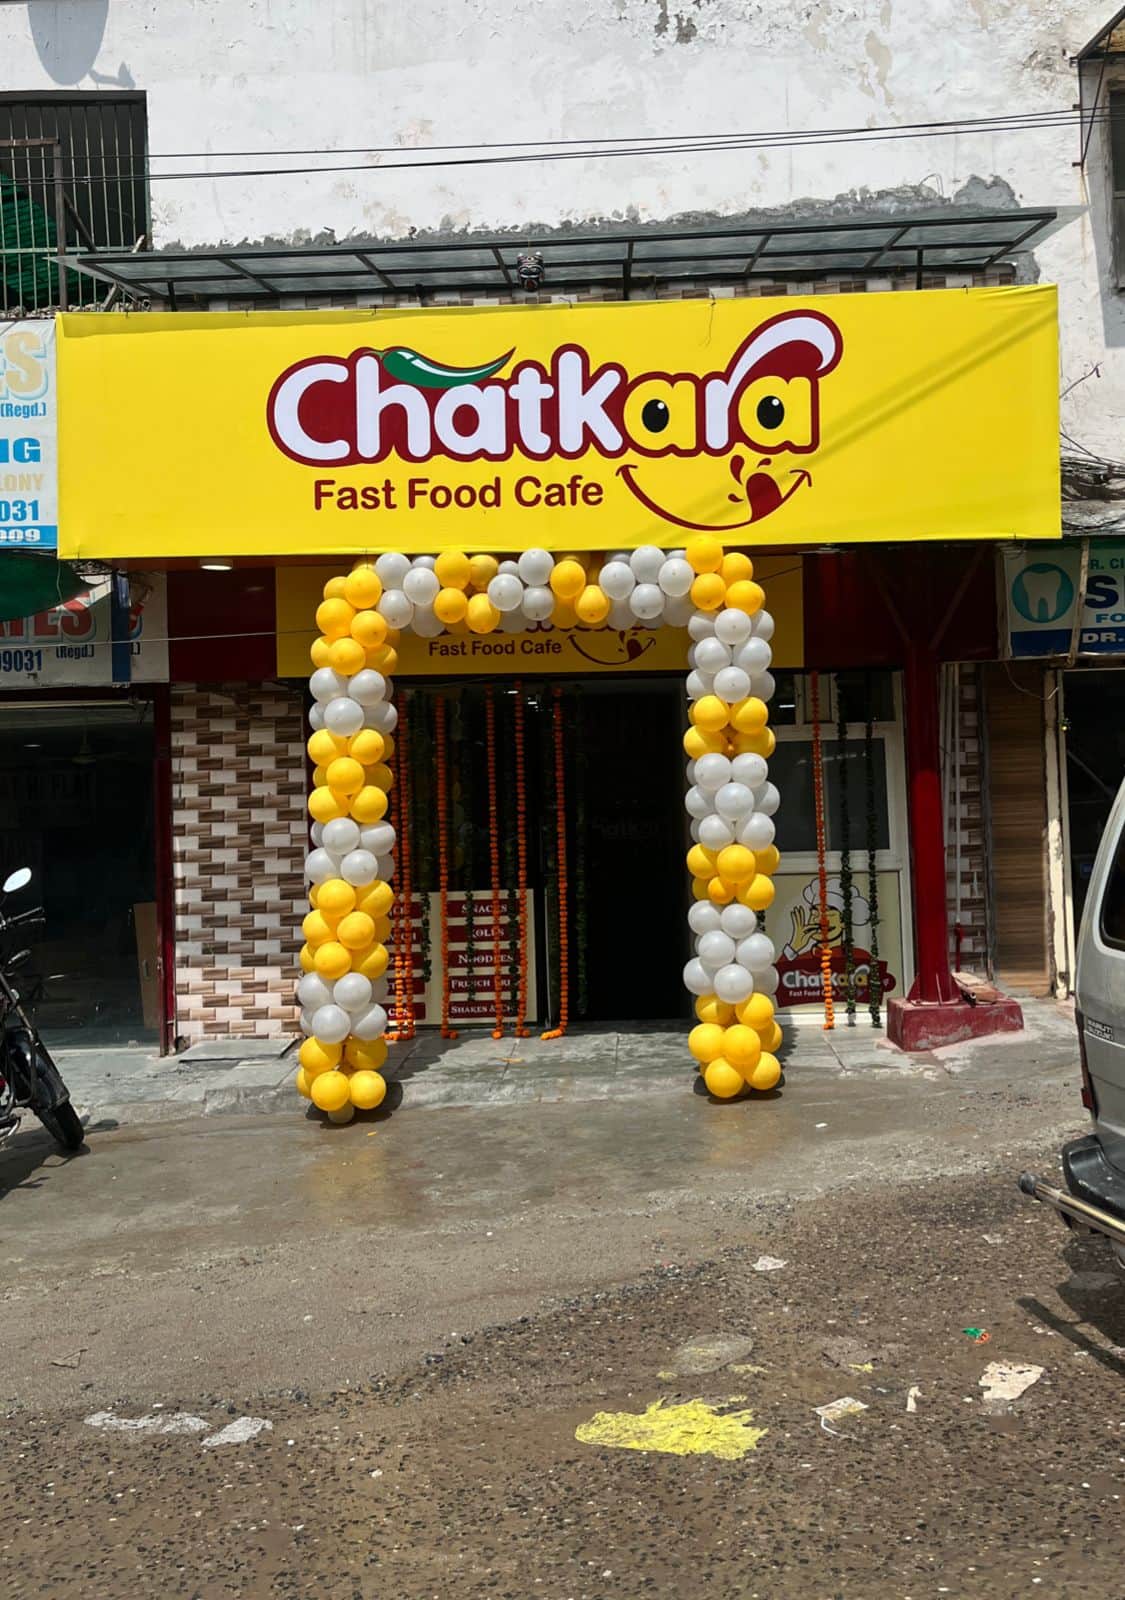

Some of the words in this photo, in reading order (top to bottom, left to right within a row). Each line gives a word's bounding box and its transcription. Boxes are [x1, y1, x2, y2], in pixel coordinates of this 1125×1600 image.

[0, 331, 48, 400] S
[267, 309, 843, 467] Chatkara
[0, 402, 46, 418] (Regd.)
[0, 473, 45, 491] ONY
[314, 480, 397, 510] Fast
[408, 477, 502, 508] Food
[514, 475, 604, 507] Cafe
[1085, 575, 1125, 609] S
[429, 641, 467, 656] Fast
[472, 640, 515, 655] Food
[526, 639, 562, 654] Cafe
[1082, 632, 1125, 643] DR.
[0, 650, 42, 672] 9031
